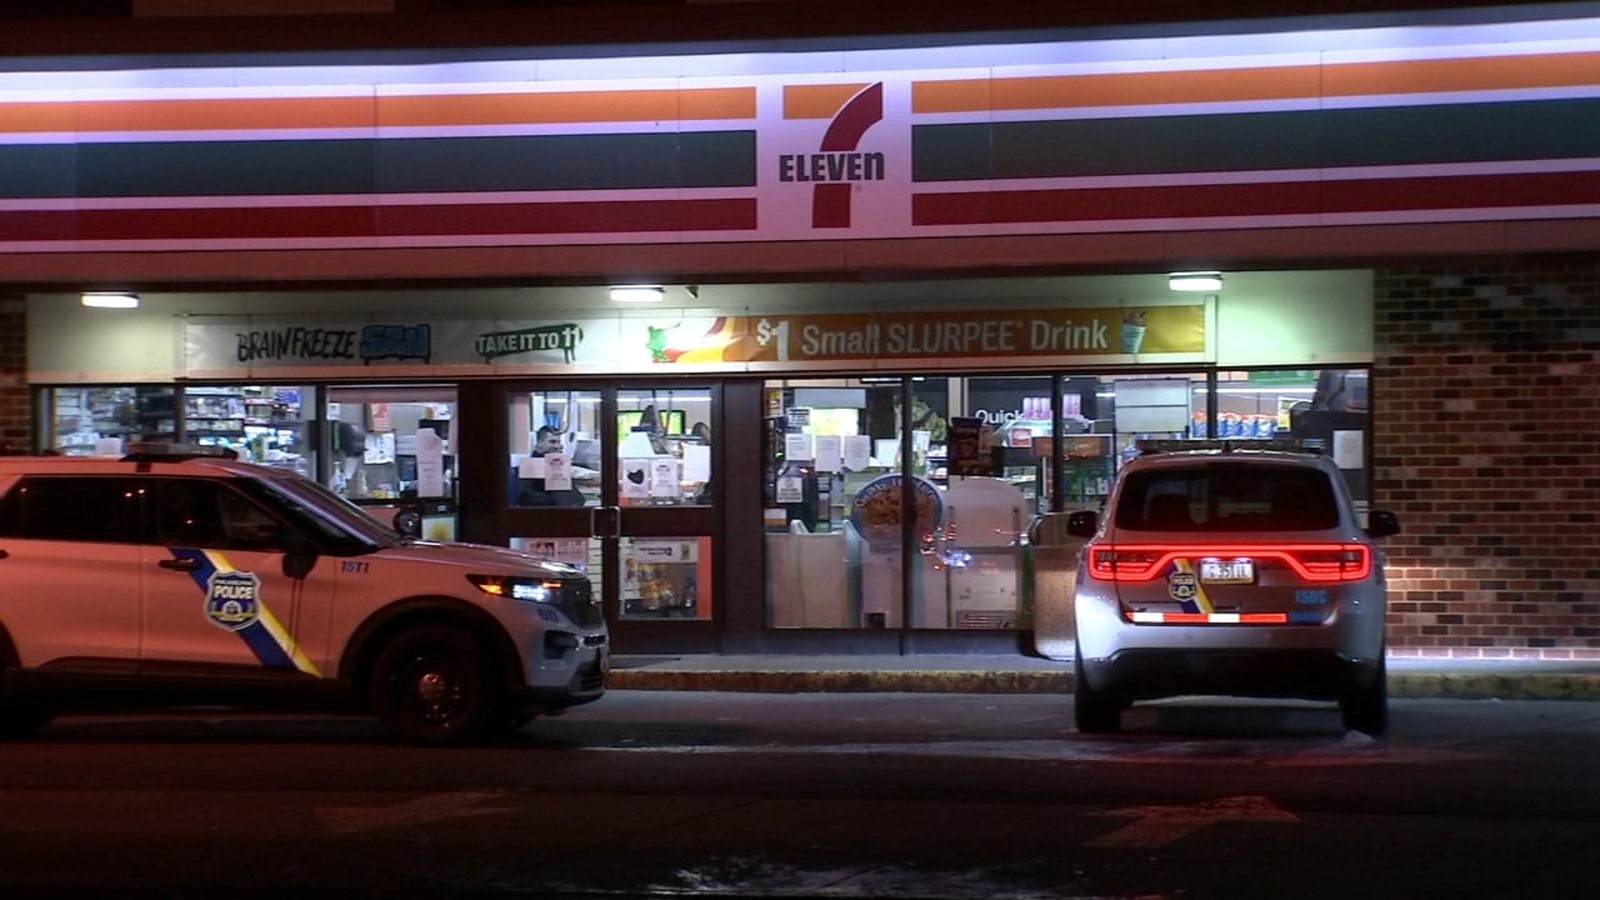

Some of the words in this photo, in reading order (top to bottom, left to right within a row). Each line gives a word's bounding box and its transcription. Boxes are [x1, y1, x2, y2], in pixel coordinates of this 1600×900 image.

[782, 81, 883, 229] 7
[478, 334, 517, 353] TAKE
[519, 333, 535, 350] IT
[537, 331, 560, 349] TO
[561, 326, 581, 348] 11
[756, 318, 789, 361] $1
[801, 324, 880, 356] Small
[1030, 318, 1108, 350] Drink
[340, 560, 370, 574] 15T1
[214, 585, 254, 599] POLICE
